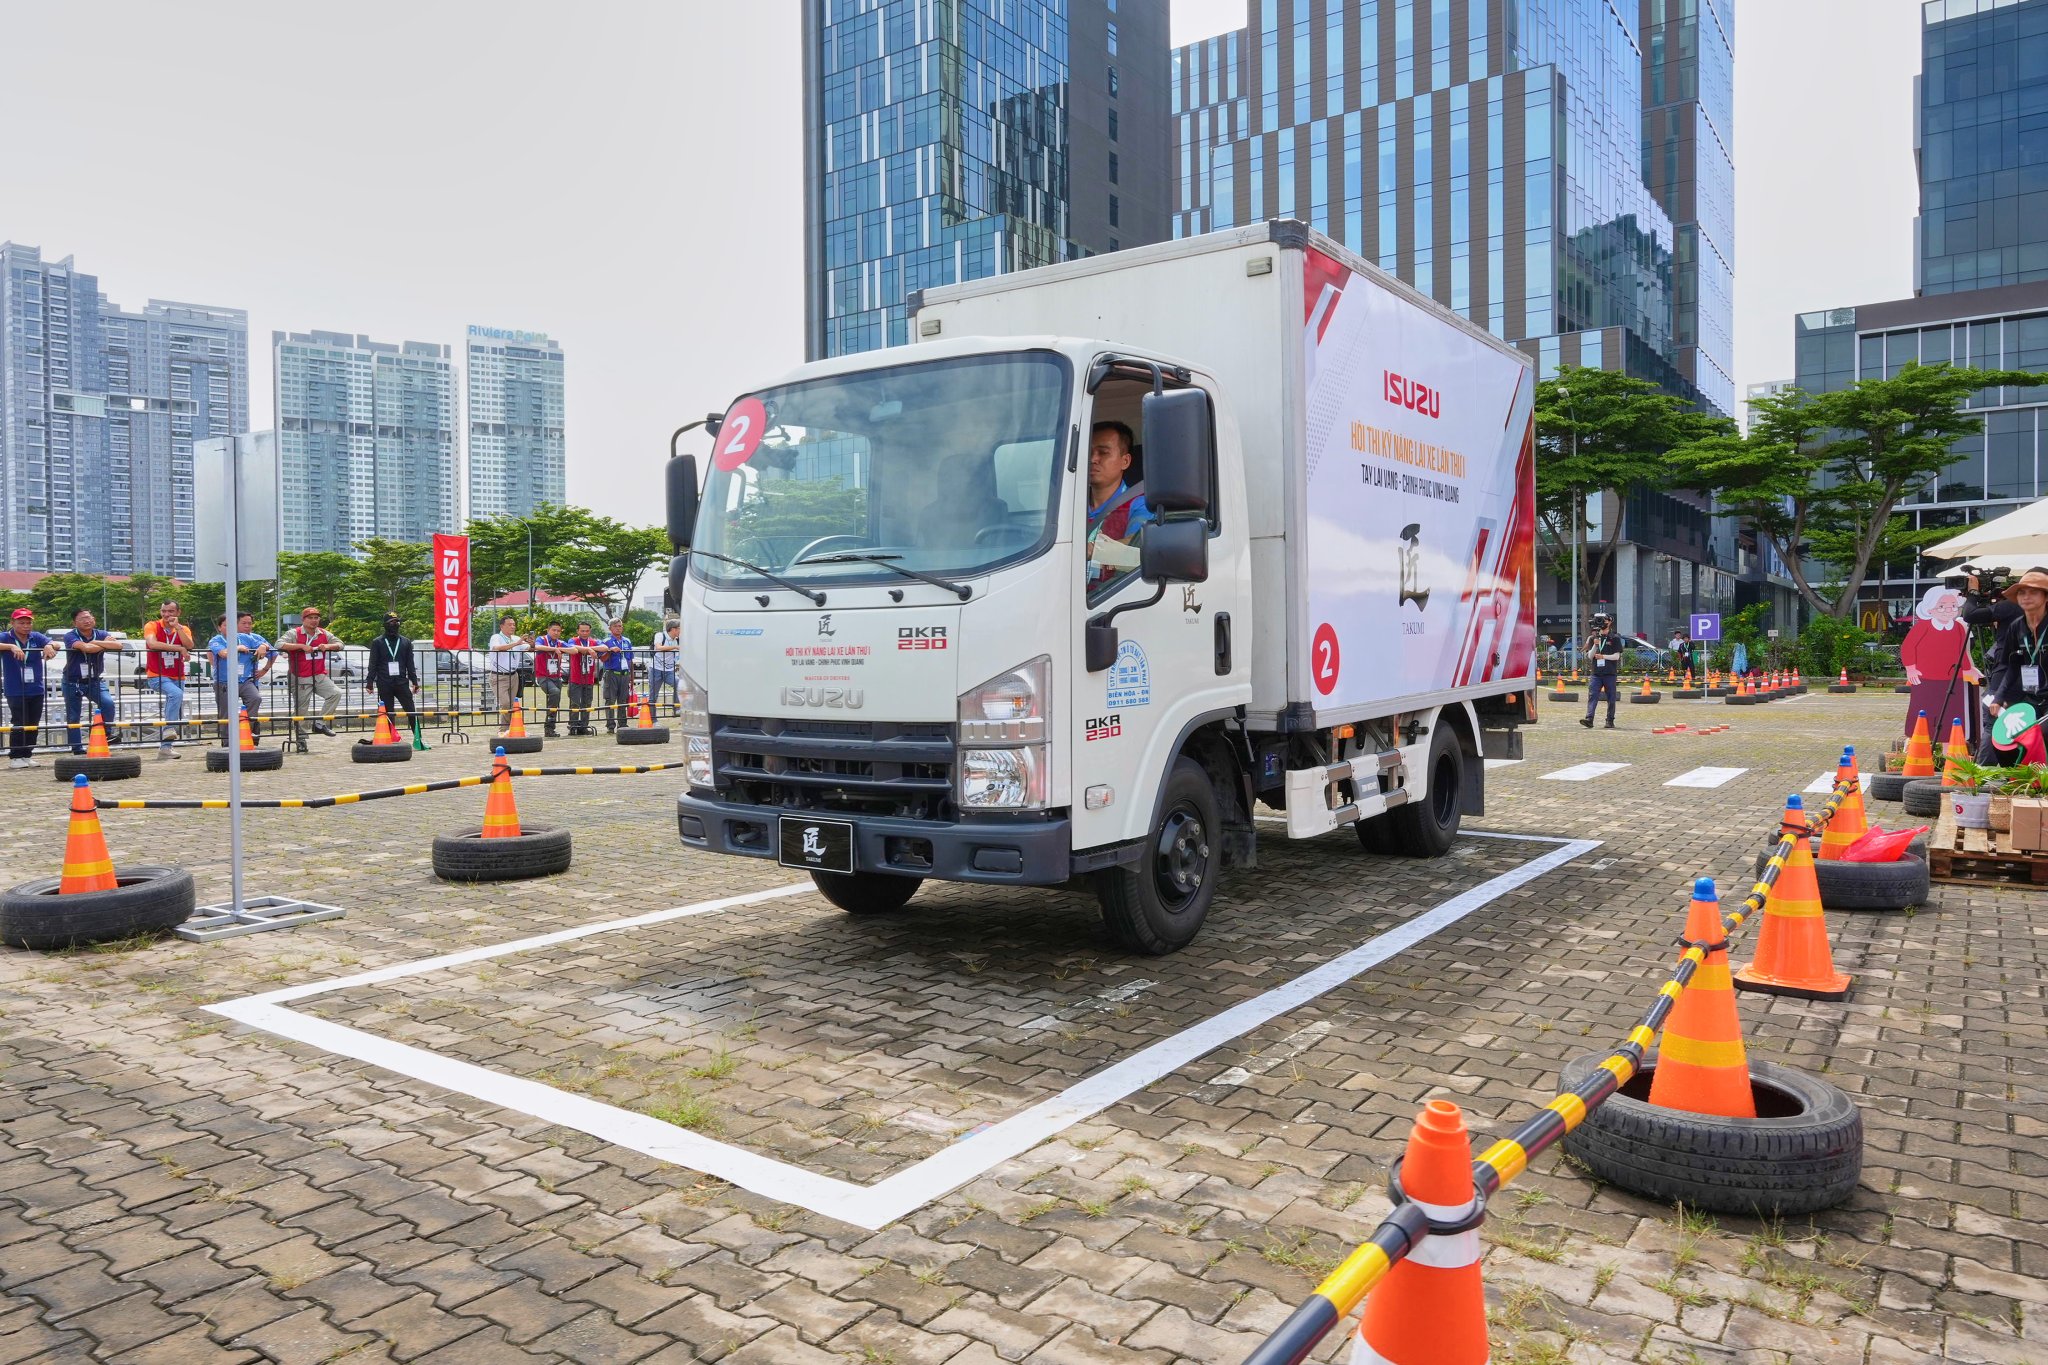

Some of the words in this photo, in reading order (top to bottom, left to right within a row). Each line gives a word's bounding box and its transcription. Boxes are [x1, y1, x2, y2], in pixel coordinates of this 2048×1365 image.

[468, 325, 514, 340] Riviera
[1383, 369, 1440, 419] ISUZU
[724, 415, 751, 455] 2
[1367, 426, 1381, 457] THI
[1427, 444, 1436, 471] XE
[1361, 463, 1374, 486] TAY
[1402, 474, 1419, 496] CHINH
[1445, 484, 1460, 504] QUANG
[443, 549, 460, 637] ISUZU
[898, 626, 947, 638] QKR
[1402, 621, 1425, 635] TAKUMI
[1698, 619, 1712, 636] P
[898, 638, 947, 650] 230
[1319, 639, 1333, 679] 2
[780, 686, 864, 709] ISUZU
[1086, 714, 1121, 730] QKR
[1086, 725, 1121, 741] 230
